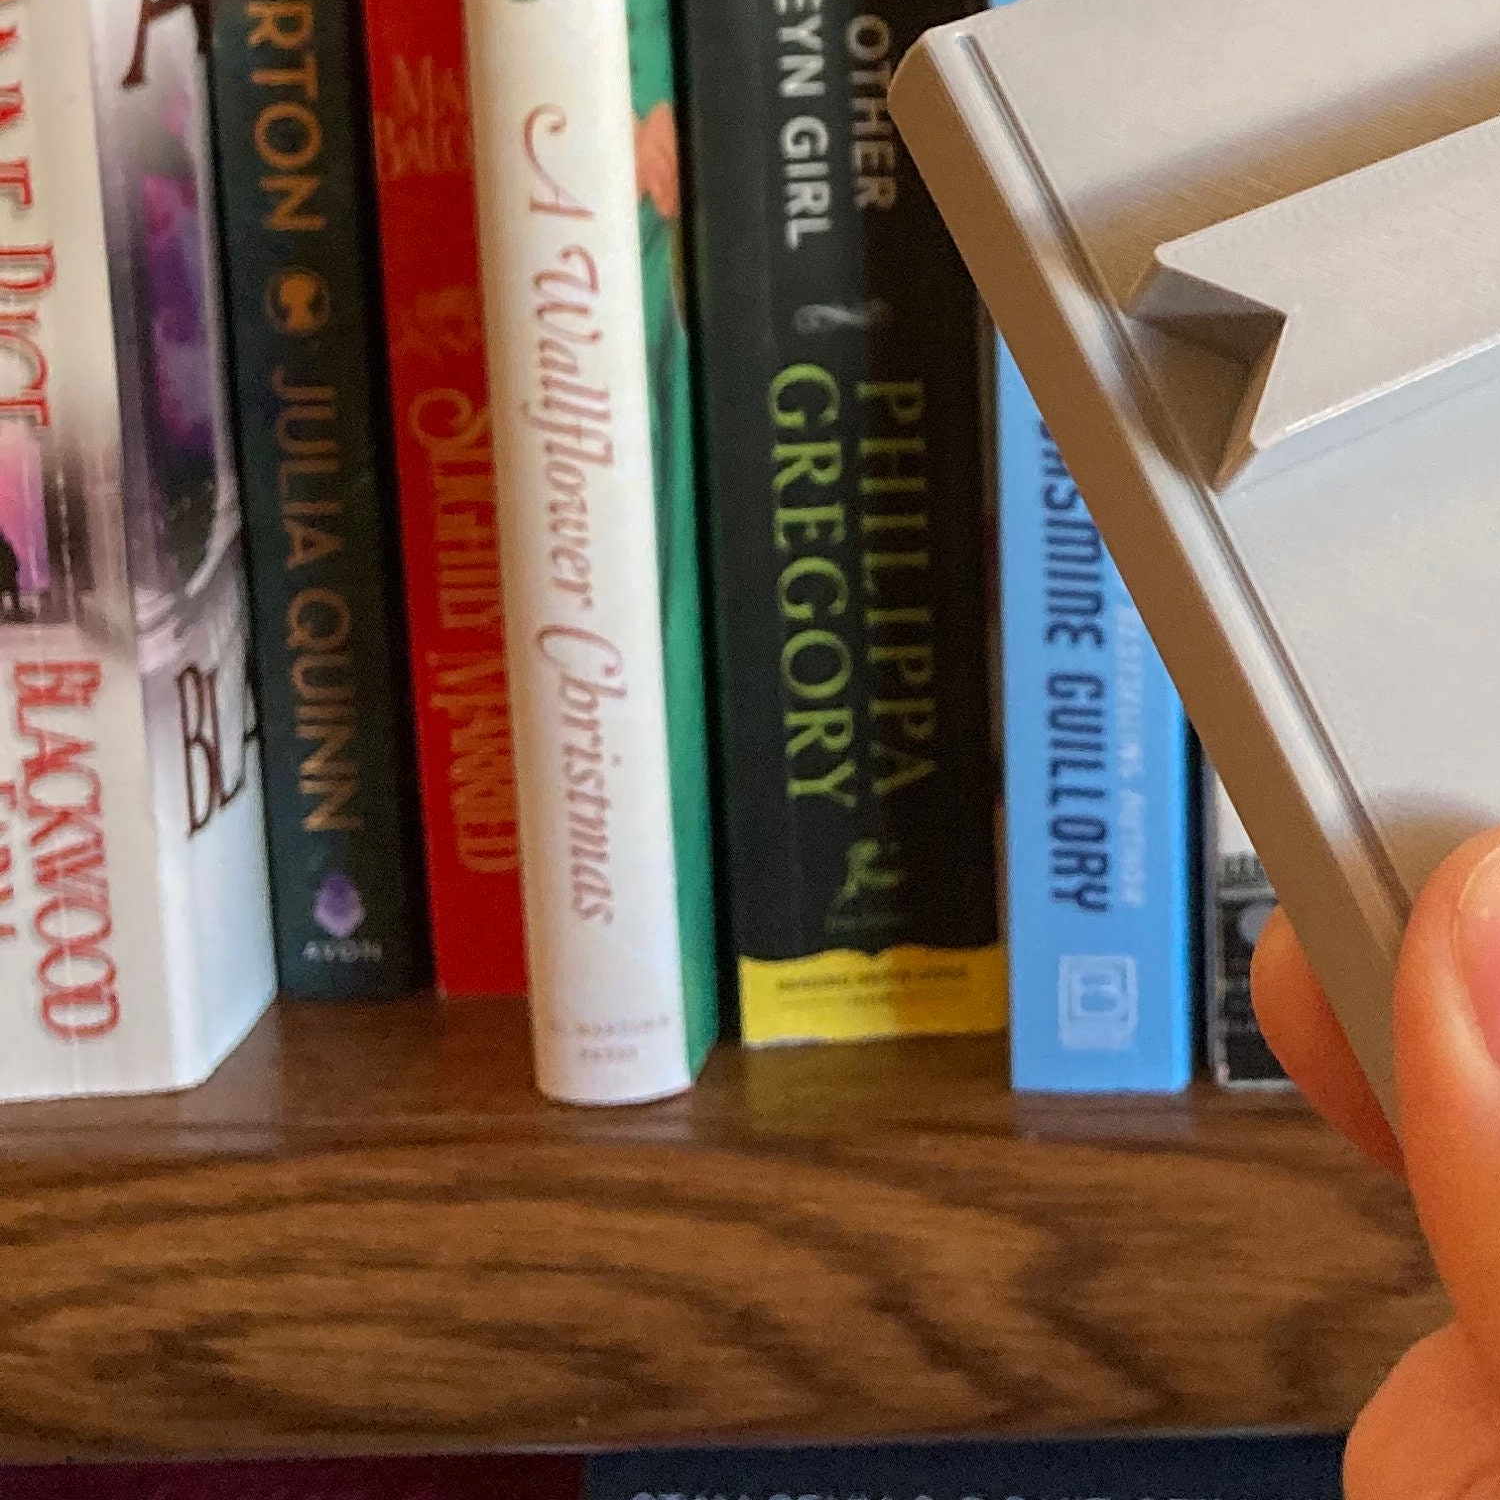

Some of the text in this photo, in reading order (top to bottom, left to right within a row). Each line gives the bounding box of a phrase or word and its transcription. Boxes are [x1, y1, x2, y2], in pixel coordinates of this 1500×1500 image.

[521, 101, 597, 224] A
[780, 115, 834, 250] GIRL
[846, 11, 899, 212] OTHER
[272, 366, 345, 571] JULIA
[522, 243, 616, 609] Wallflower
[284, 589, 362, 834] QUINN
[766, 362, 858, 810] GREGORY
[856, 379, 938, 797] PHILIPPA
[1038, 420, 1113, 916] ASMINE GUILLORY
[12, 657, 121, 1043] BLACKWOOD
[535, 620, 629, 928] Christmas
